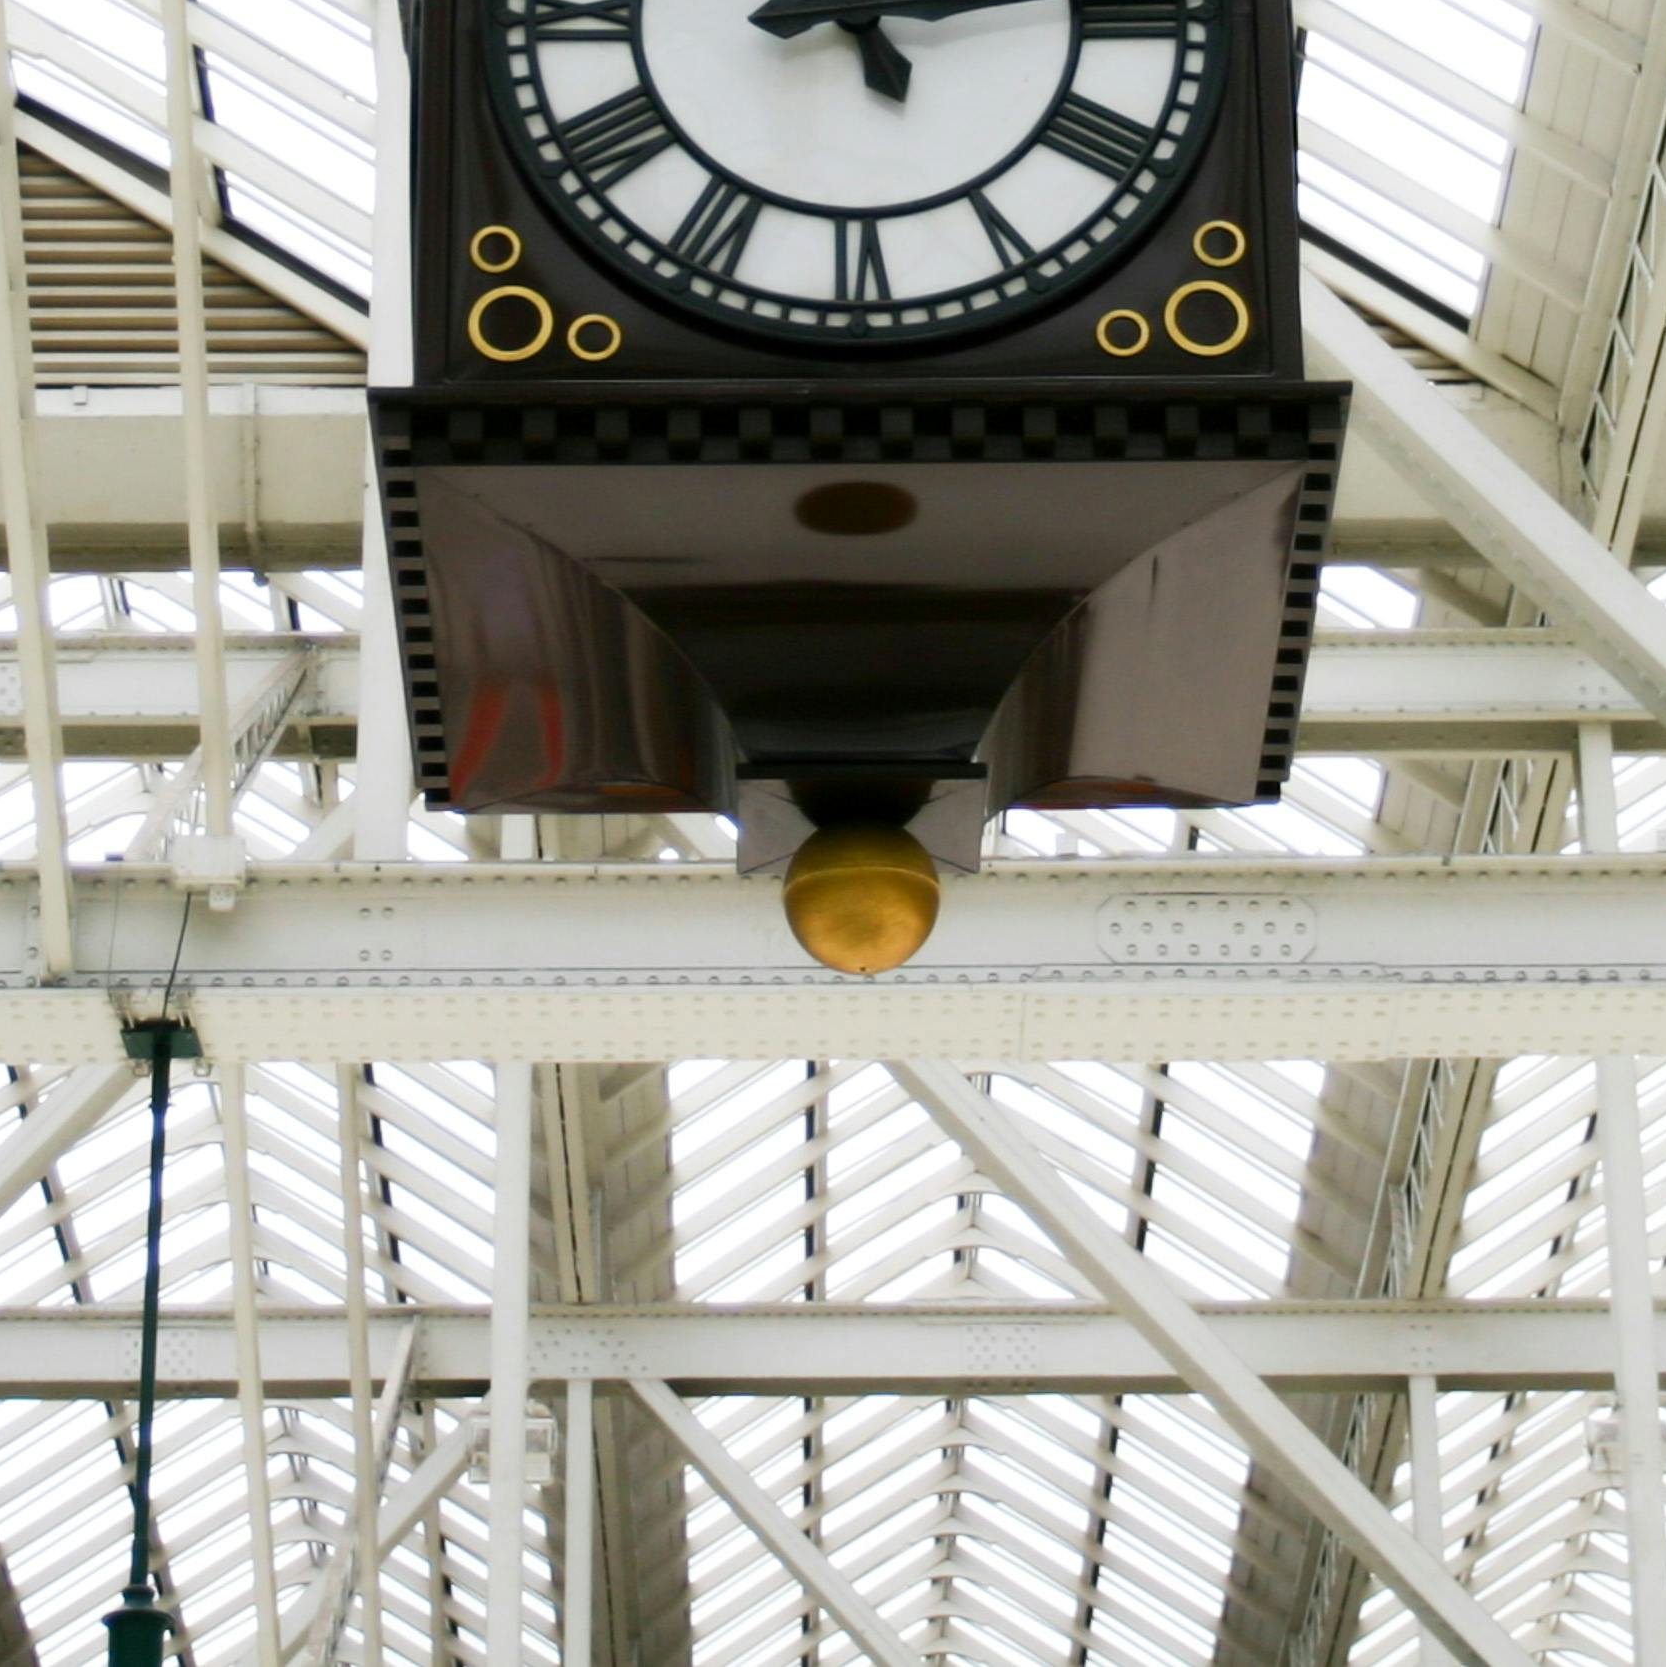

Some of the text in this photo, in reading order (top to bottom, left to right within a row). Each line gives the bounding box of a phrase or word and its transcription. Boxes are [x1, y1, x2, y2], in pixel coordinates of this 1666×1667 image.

[559, 85, 679, 193] VIII
[1038, 90, 1159, 183] IIII
[668, 174, 763, 277] VII
[834, 218, 892, 301] VI
[967, 189, 1037, 270] V
